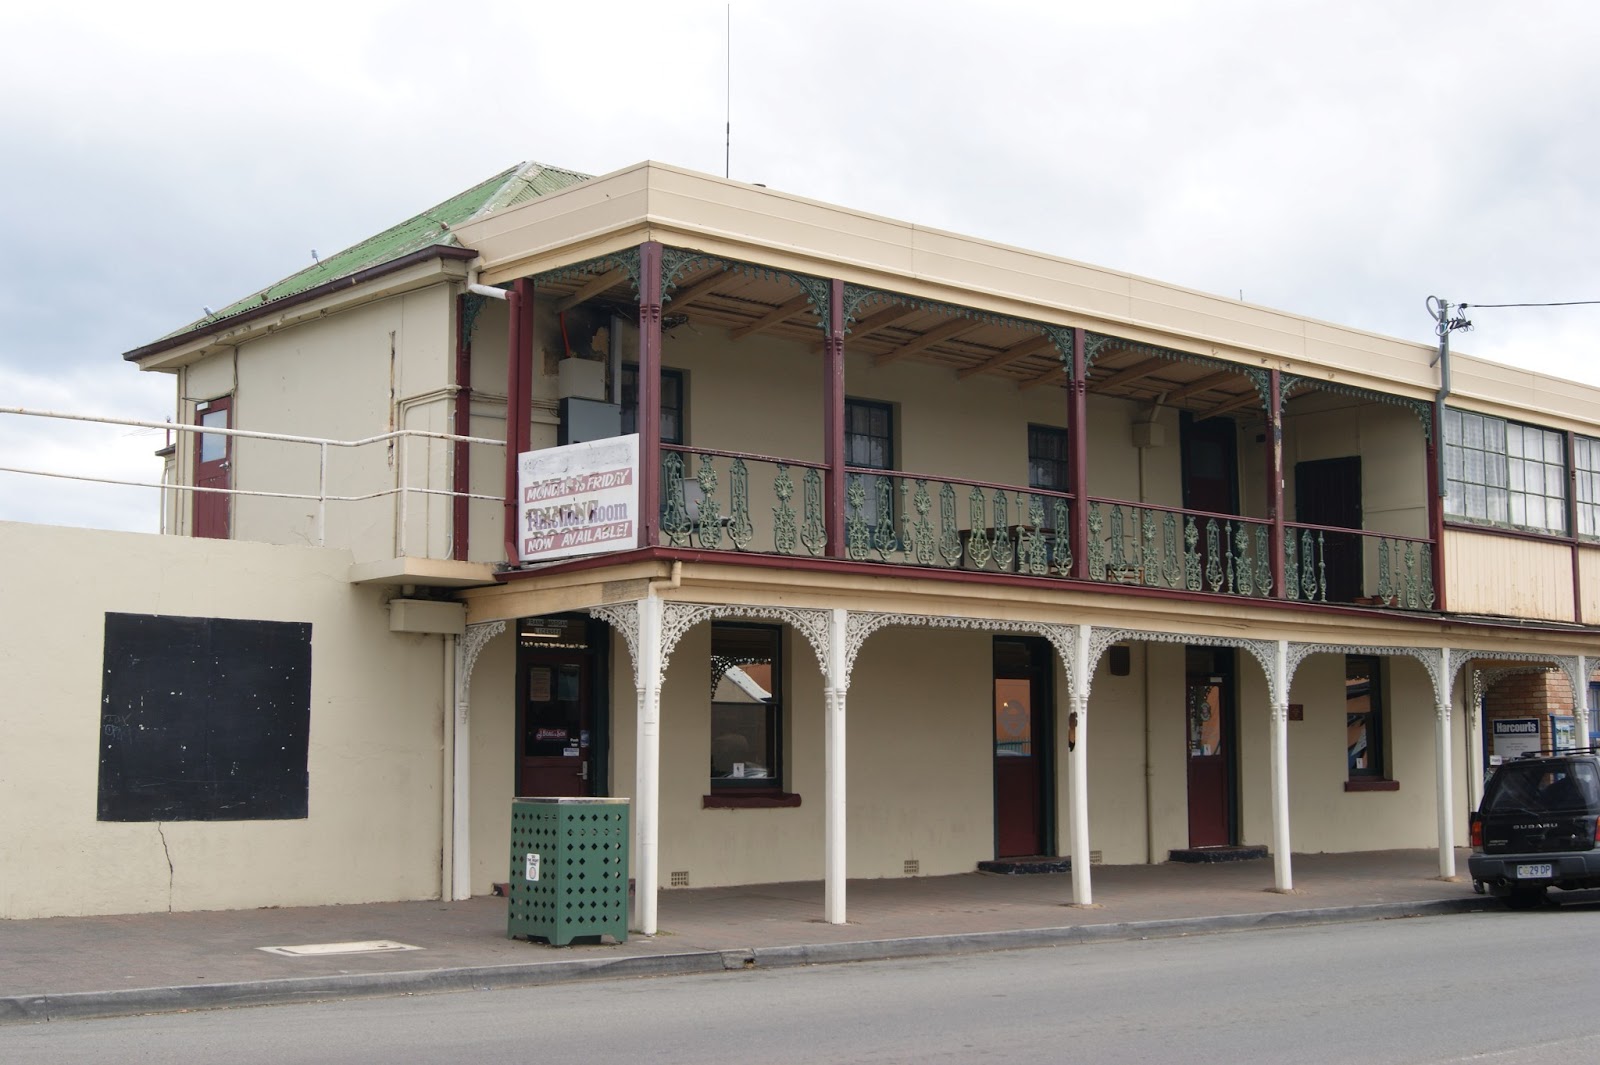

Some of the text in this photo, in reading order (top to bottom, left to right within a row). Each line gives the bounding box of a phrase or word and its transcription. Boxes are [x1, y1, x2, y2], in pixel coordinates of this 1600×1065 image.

[526, 482, 572, 501] MONDAY
[587, 469, 630, 490] FRIDAY
[527, 536, 555, 552] NOW
[561, 523, 629, 547] AVAILABLE!
[1496, 721, 1537, 733] Harcourts
